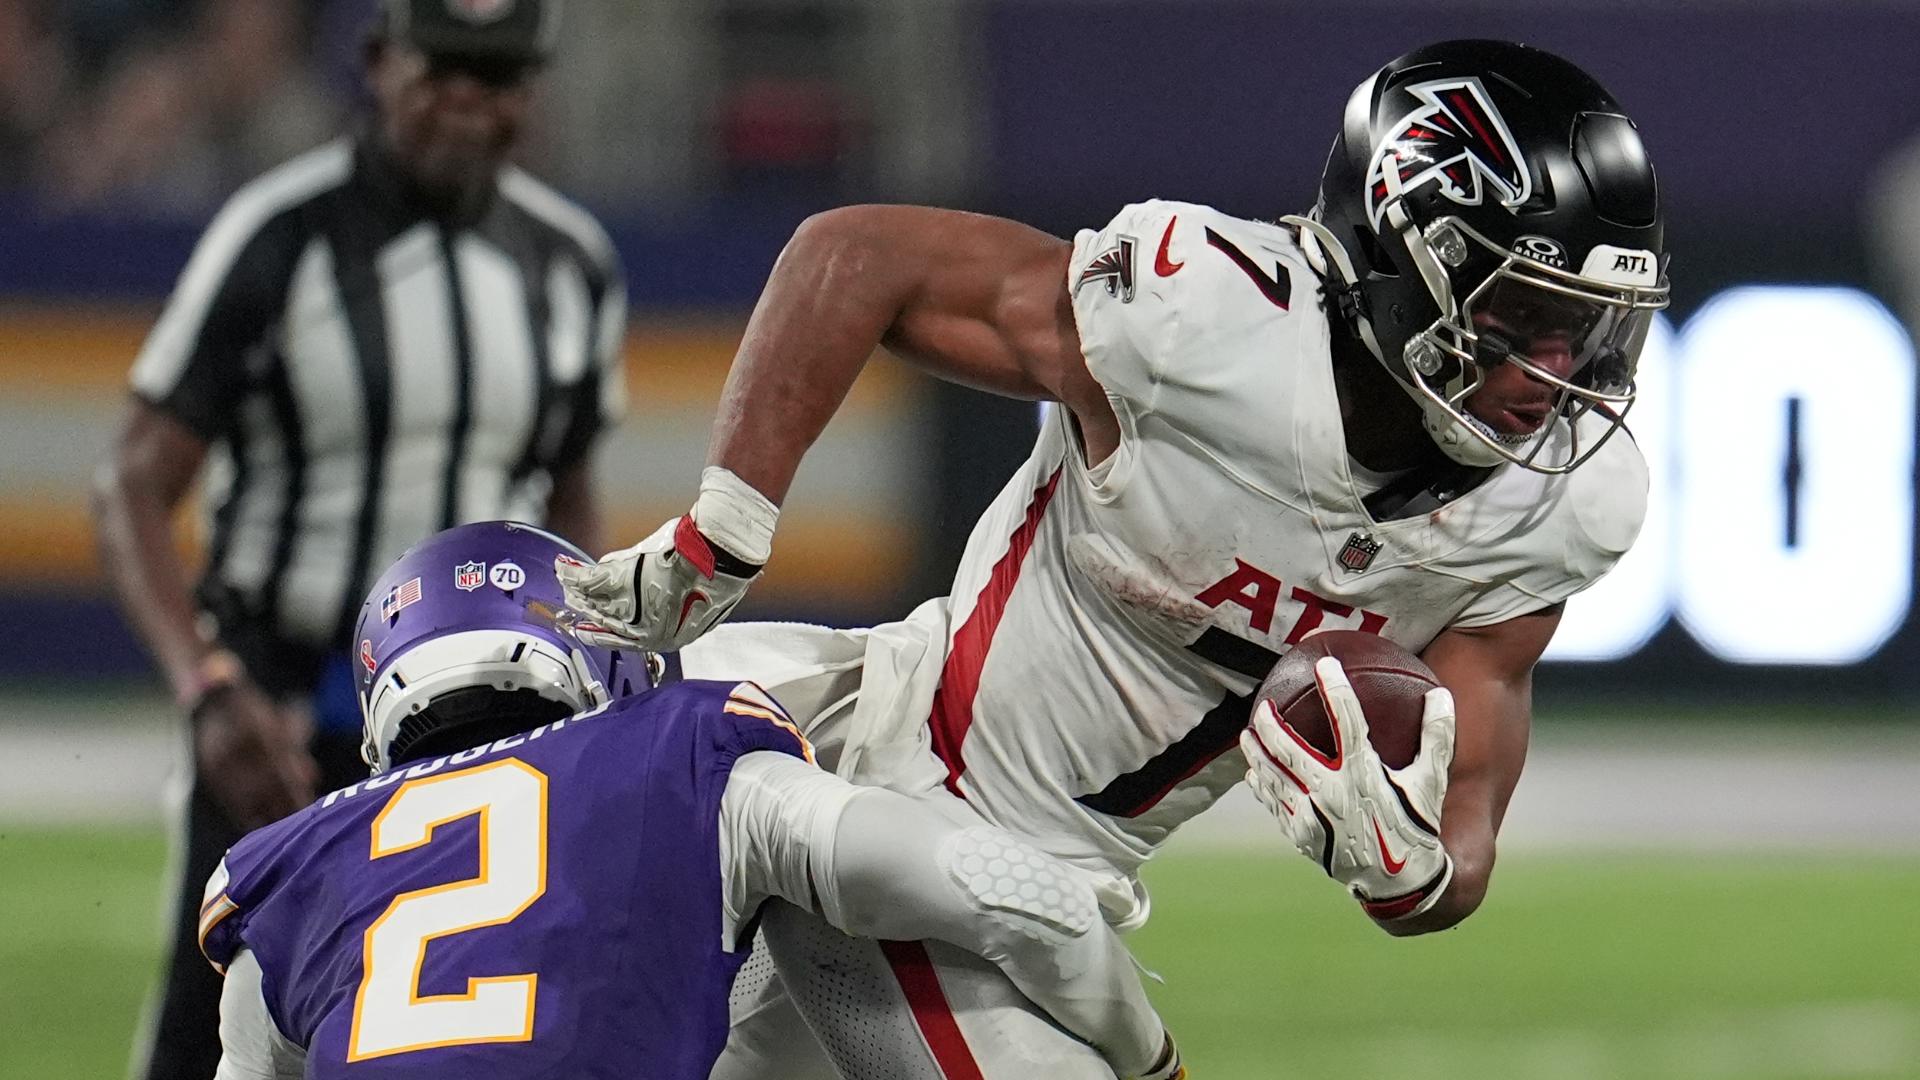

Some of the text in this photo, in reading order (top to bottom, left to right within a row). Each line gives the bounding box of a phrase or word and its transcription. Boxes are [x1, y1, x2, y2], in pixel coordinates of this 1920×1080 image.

[1514, 245, 1565, 268] OAKLEY
[1612, 254, 1648, 274] ATL
[1204, 225, 1292, 312] 7
[460, 574, 481, 586] NFL
[496, 568, 520, 584] 70
[347, 756, 548, 1063] 2
